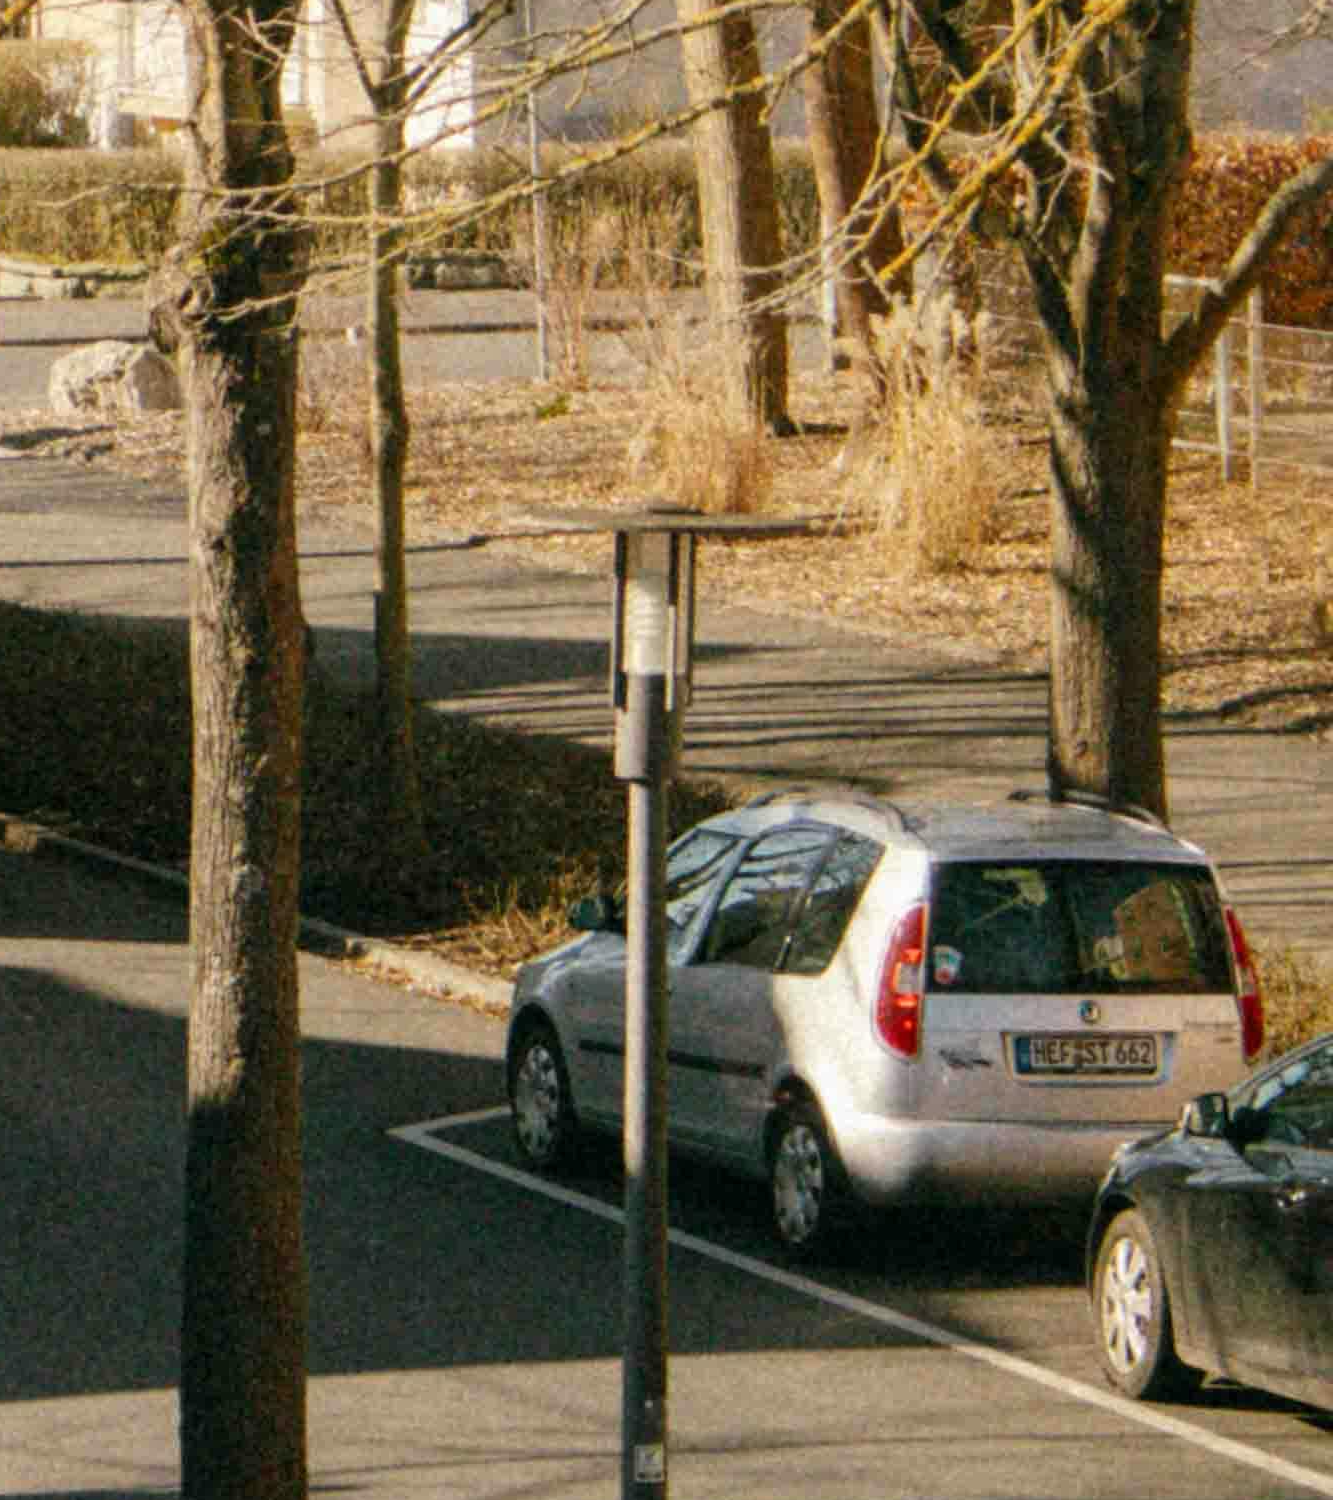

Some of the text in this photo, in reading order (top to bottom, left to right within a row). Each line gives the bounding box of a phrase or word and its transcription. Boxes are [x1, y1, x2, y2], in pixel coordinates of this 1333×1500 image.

[1034, 1039, 1151, 1065] HEF ST 662
